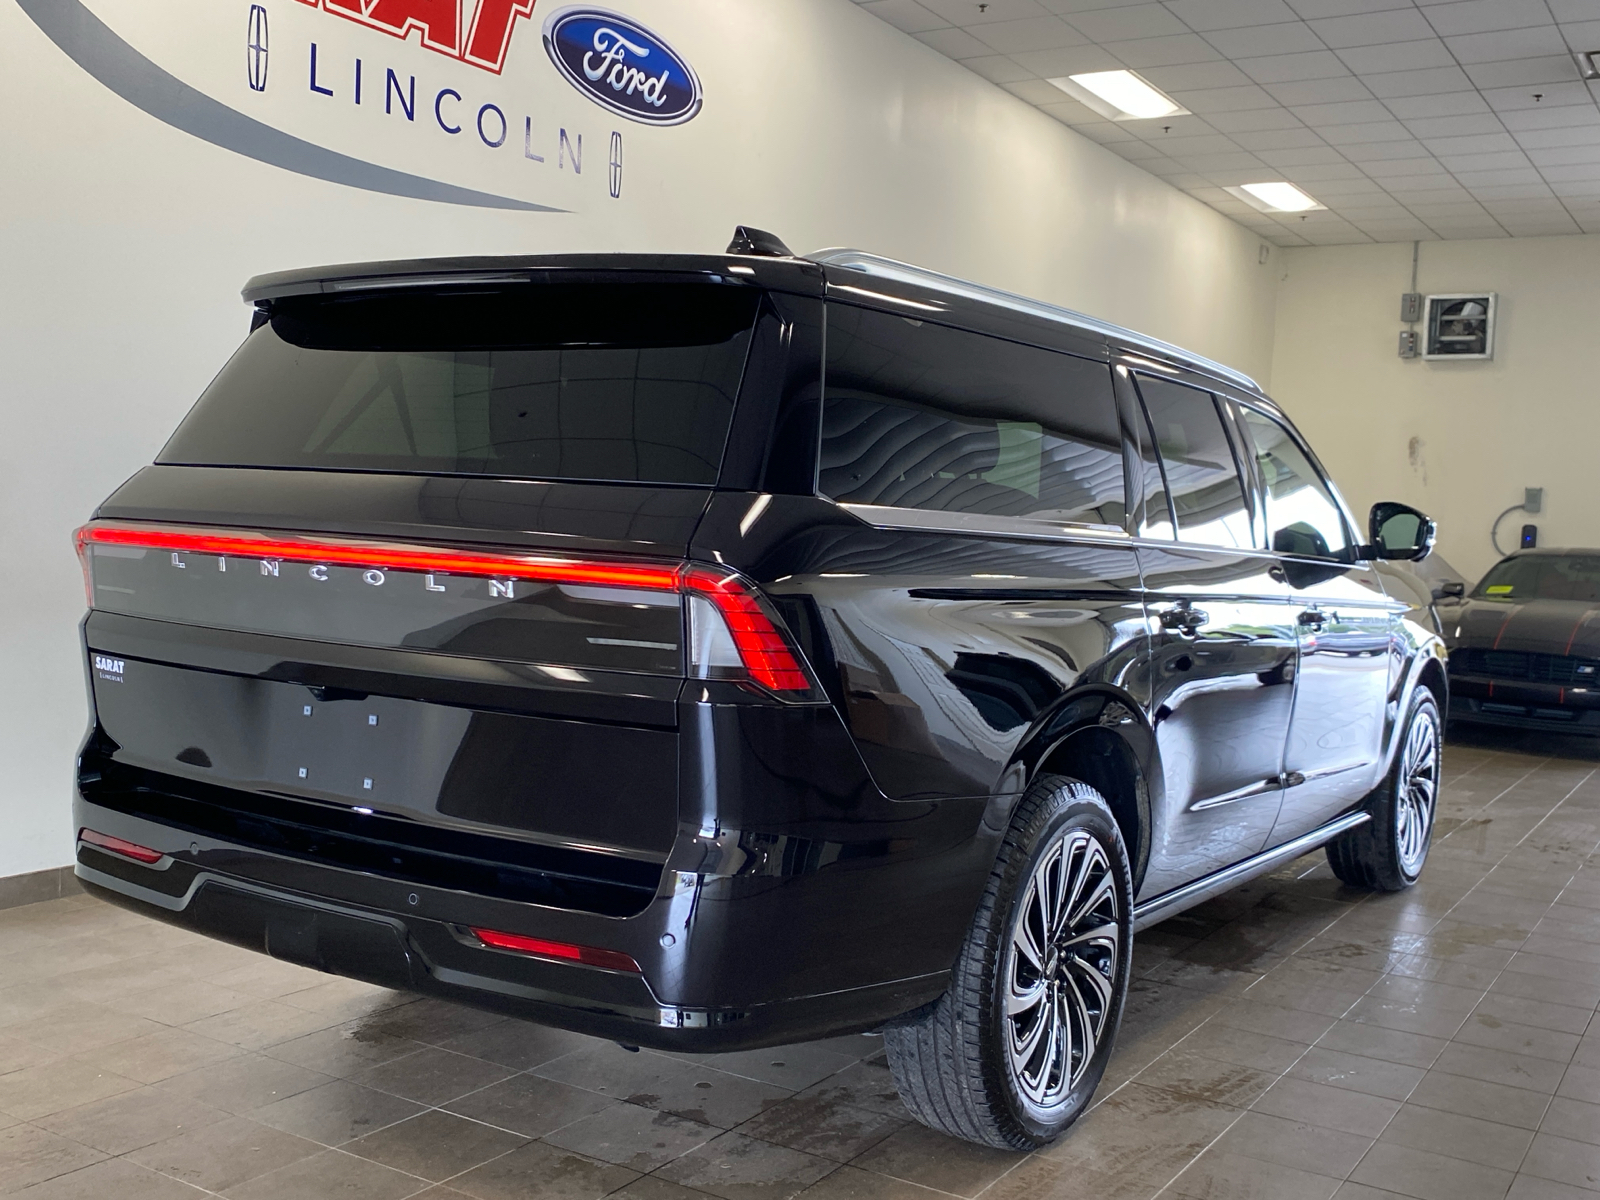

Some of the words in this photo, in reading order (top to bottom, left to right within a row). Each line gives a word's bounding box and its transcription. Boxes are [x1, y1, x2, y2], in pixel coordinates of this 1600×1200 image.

[583, 27, 670, 107] Ford
[310, 42, 583, 175] LINCOLN
[171, 552, 515, 599] LINCOLN
[95, 656, 124, 673] SARAT
